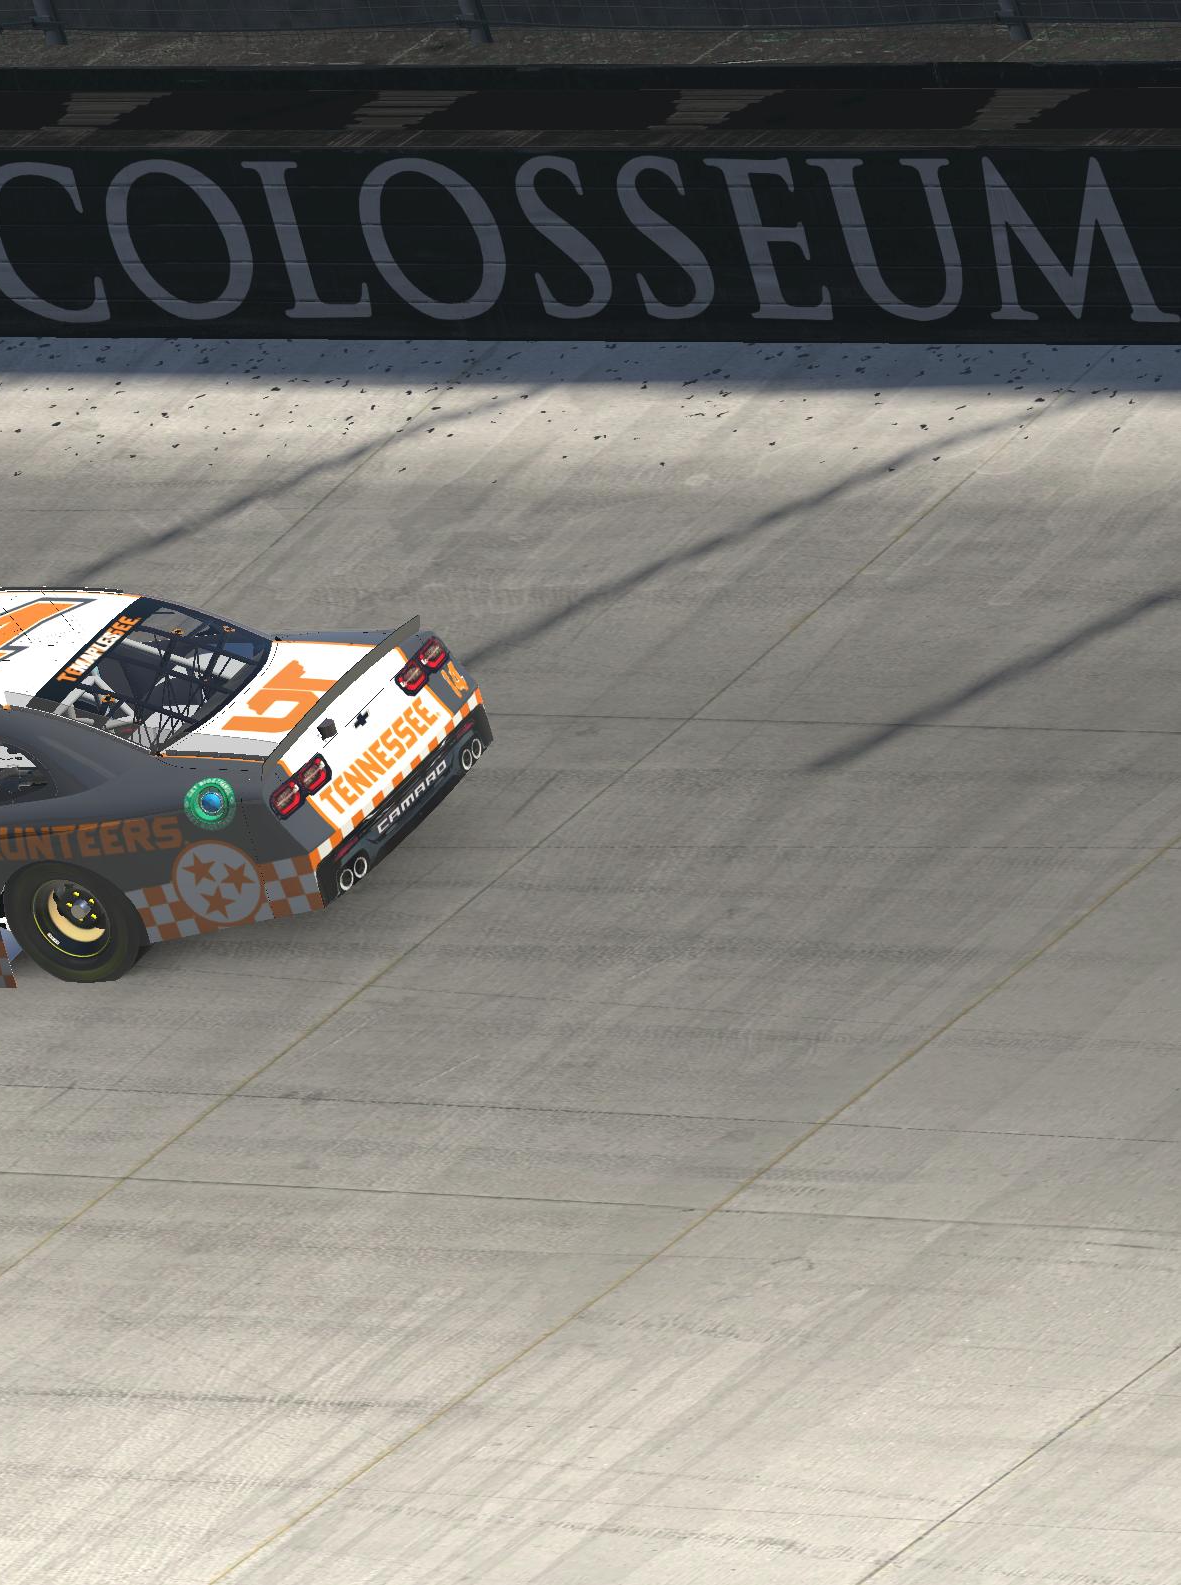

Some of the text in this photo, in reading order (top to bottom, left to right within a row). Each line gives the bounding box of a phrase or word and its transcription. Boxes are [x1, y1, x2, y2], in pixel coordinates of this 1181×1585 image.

[440, 660, 469, 699] 14
[319, 696, 439, 814] TENNESSEE
[377, 759, 447, 834] CAMARO
